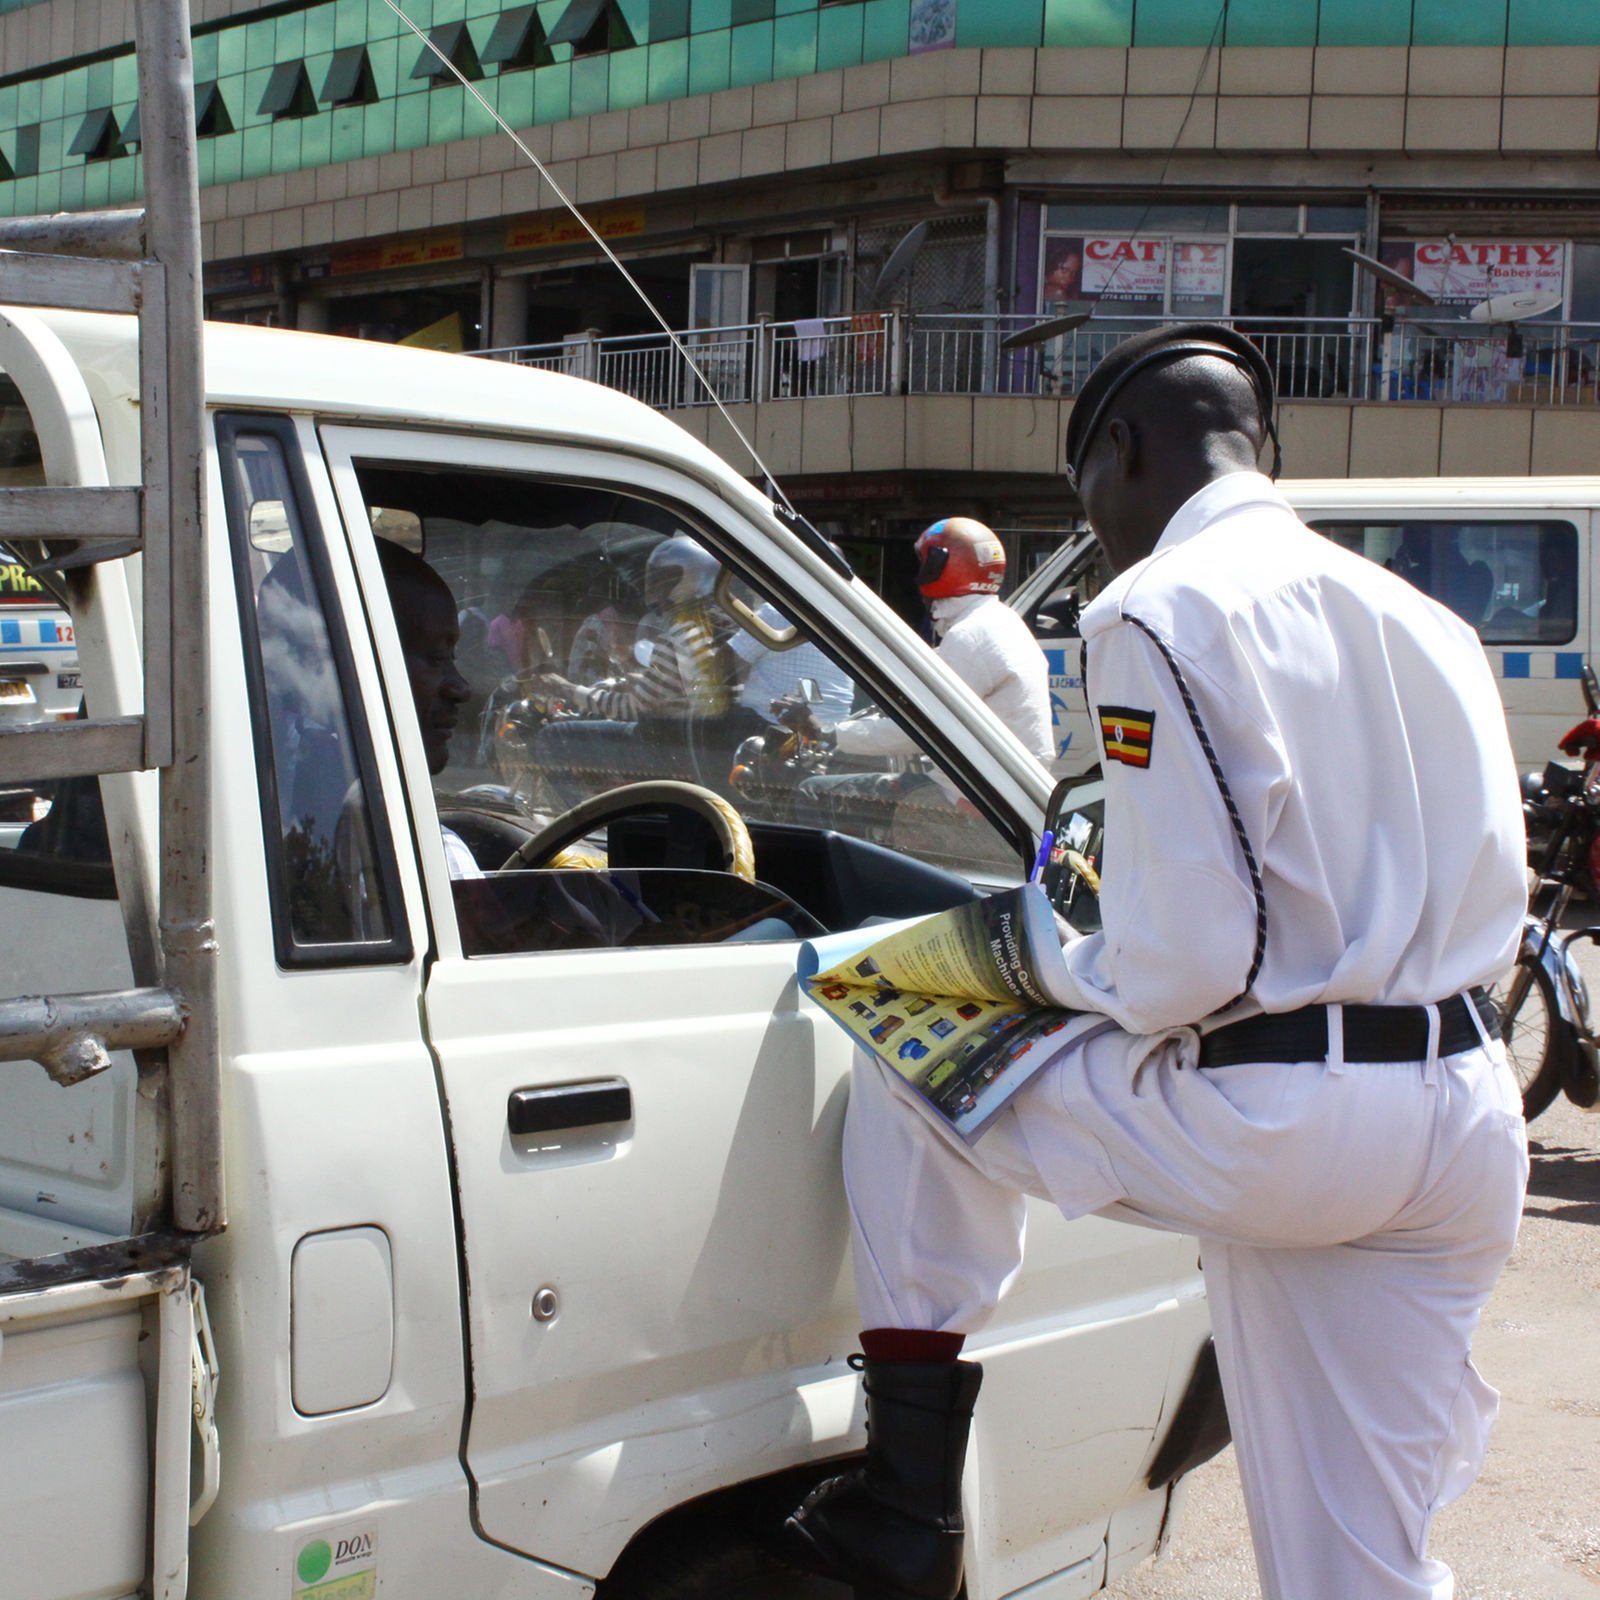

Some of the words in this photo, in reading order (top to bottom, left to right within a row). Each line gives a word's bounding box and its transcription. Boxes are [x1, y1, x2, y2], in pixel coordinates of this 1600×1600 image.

[1417, 244, 1559, 265] CATHY
[1000, 912, 1021, 970] Providing
[990, 937, 1023, 997] Machines
[335, 1531, 373, 1559] DON
